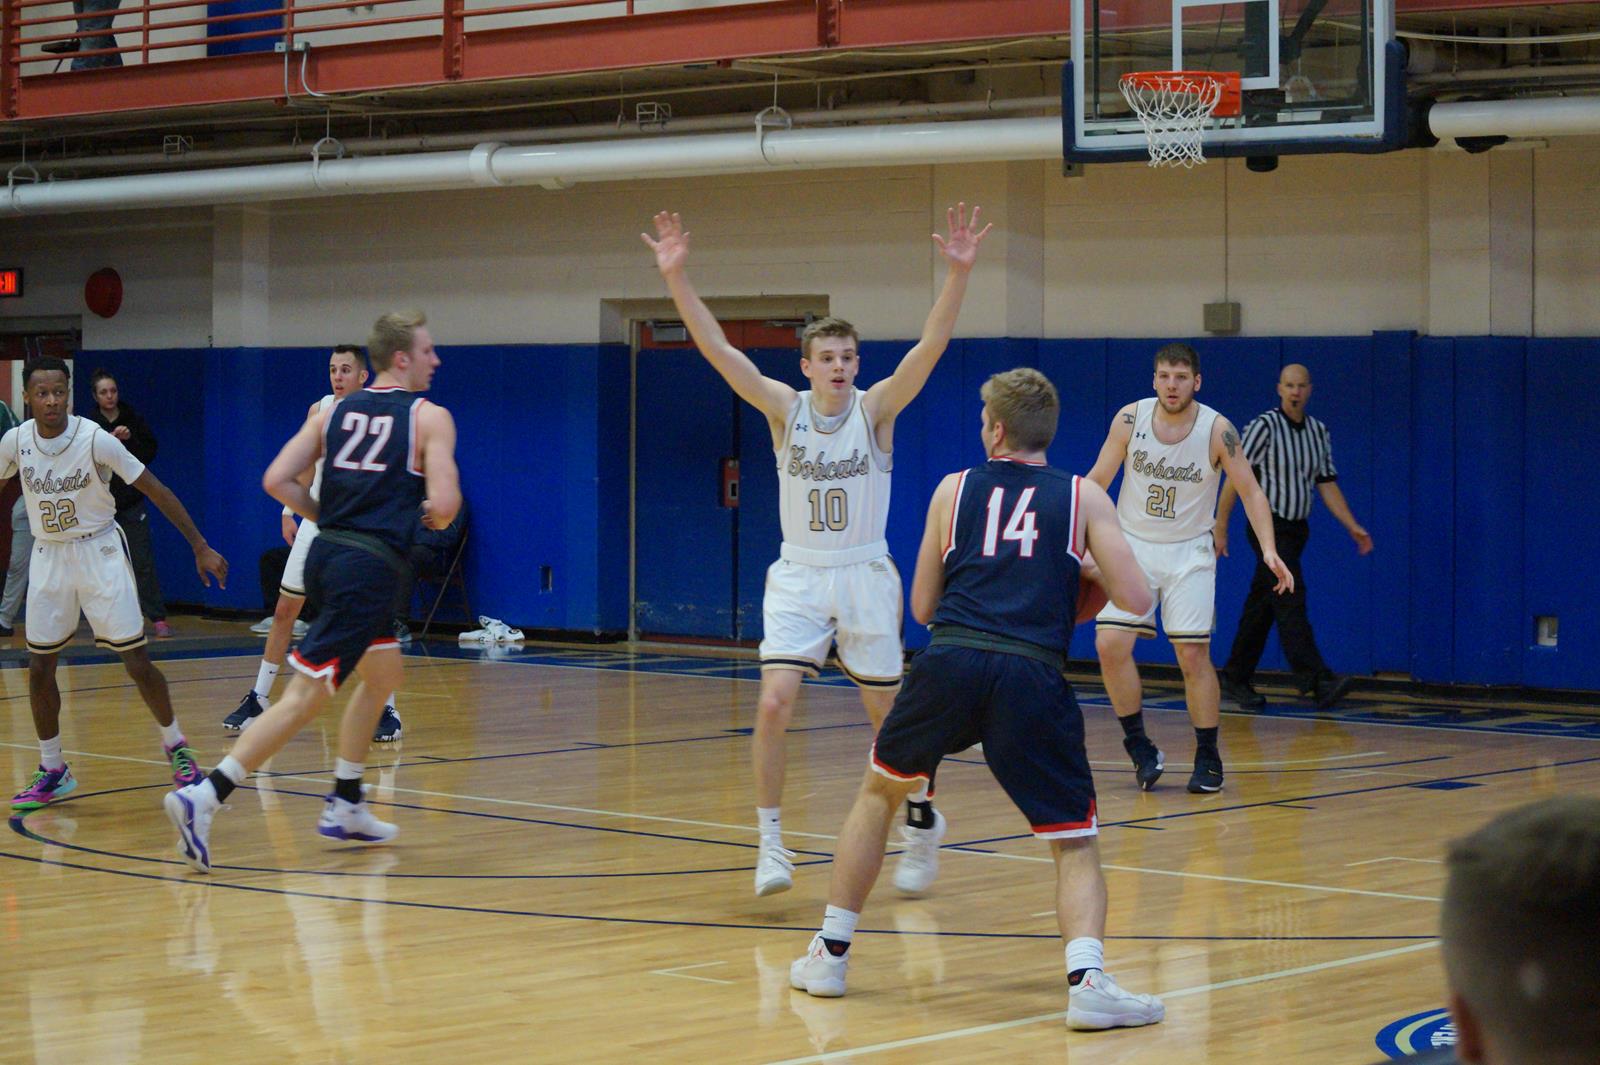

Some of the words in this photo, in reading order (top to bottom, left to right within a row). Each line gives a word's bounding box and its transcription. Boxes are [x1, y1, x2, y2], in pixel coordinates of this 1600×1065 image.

[333, 411, 395, 472] 22
[22, 466, 91, 494] Bobcats
[788, 444, 870, 481] Bobcats
[1132, 449, 1203, 484] Bobcats
[39, 498, 79, 533] 22
[808, 488, 848, 531] 10
[1145, 484, 1177, 519] 21
[982, 486, 1039, 557] 14
